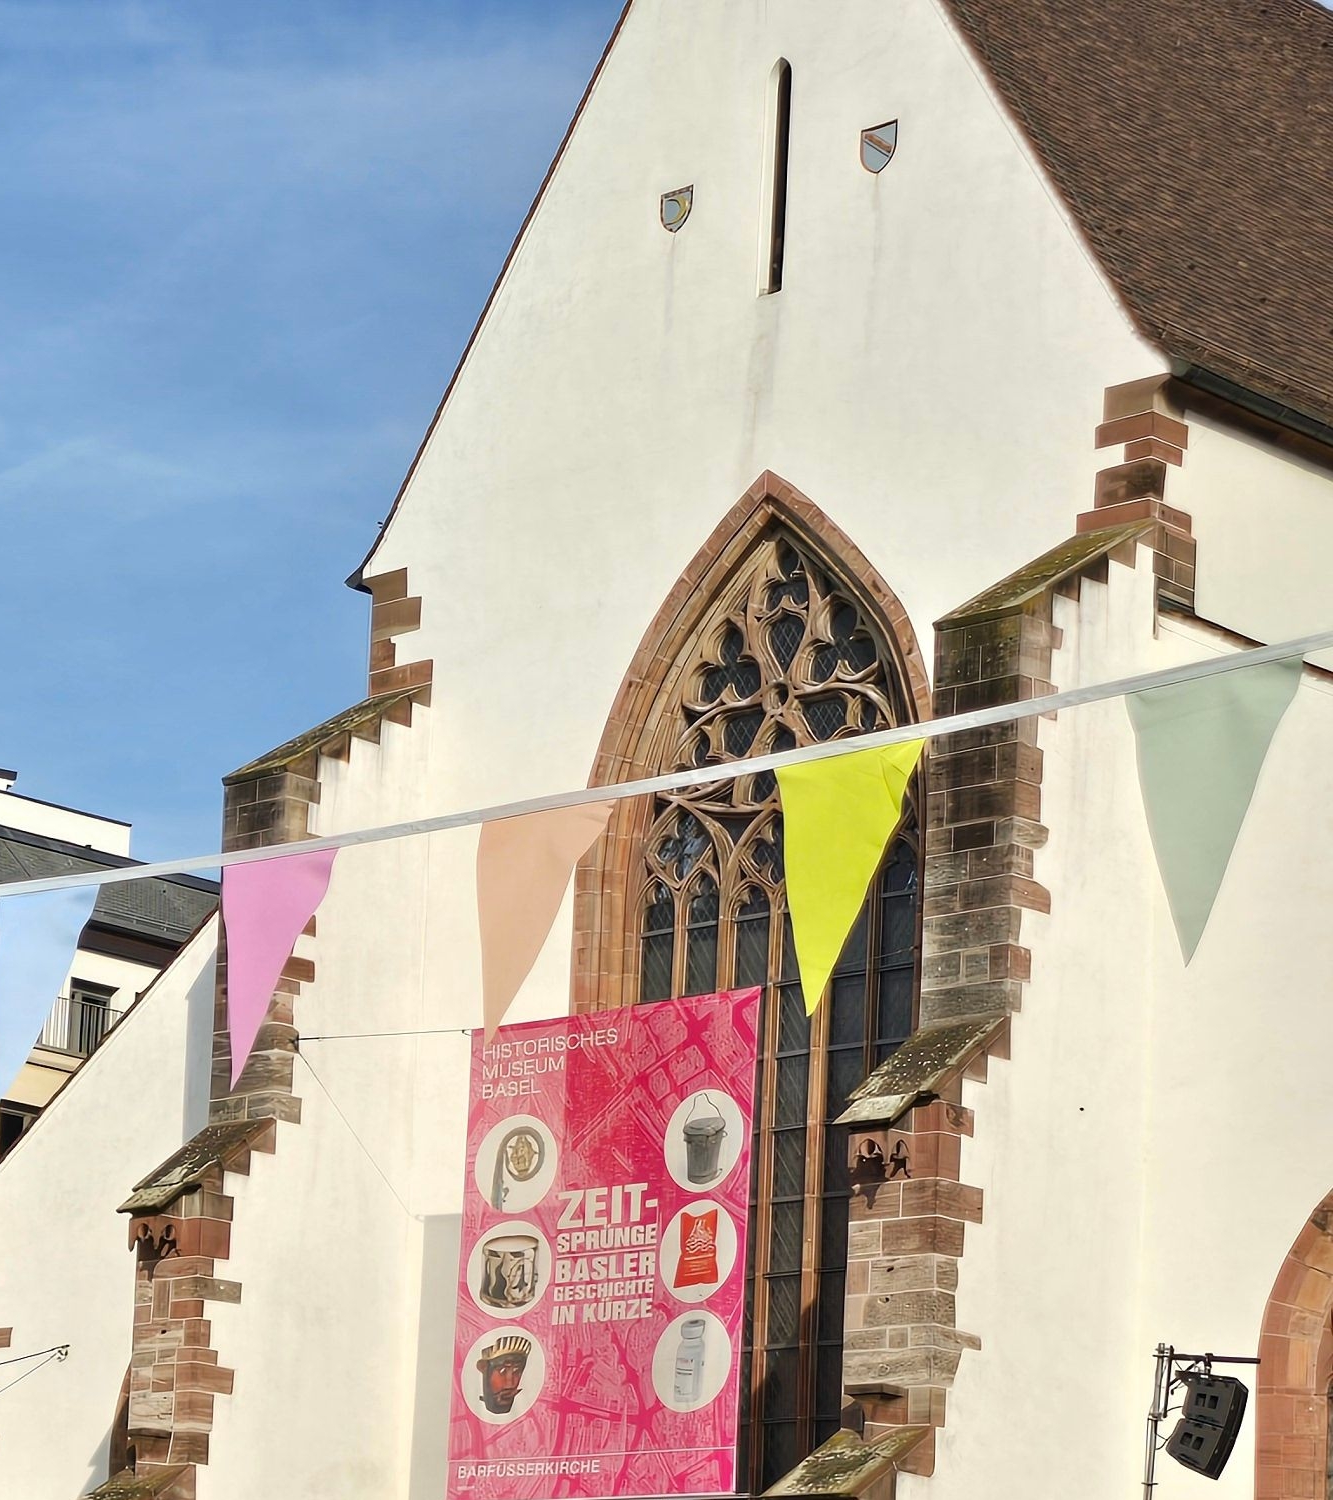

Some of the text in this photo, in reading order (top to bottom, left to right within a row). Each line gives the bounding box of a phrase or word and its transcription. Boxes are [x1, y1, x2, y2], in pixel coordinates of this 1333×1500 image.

[483, 1028, 619, 1061] HISTORISCHES
[483, 1056, 565, 1080] MUSEUM
[483, 1078, 542, 1100] BASEL
[557, 1183, 659, 1230] ZEIT-
[556, 1223, 658, 1254] SPRÜNGE
[555, 1251, 656, 1284] BASLER
[553, 1278, 655, 1302] GESCHICHTE
[551, 1298, 653, 1326] IN KÜRZE
[457, 1459, 601, 1479] BARFÜSSERKIRCHE
